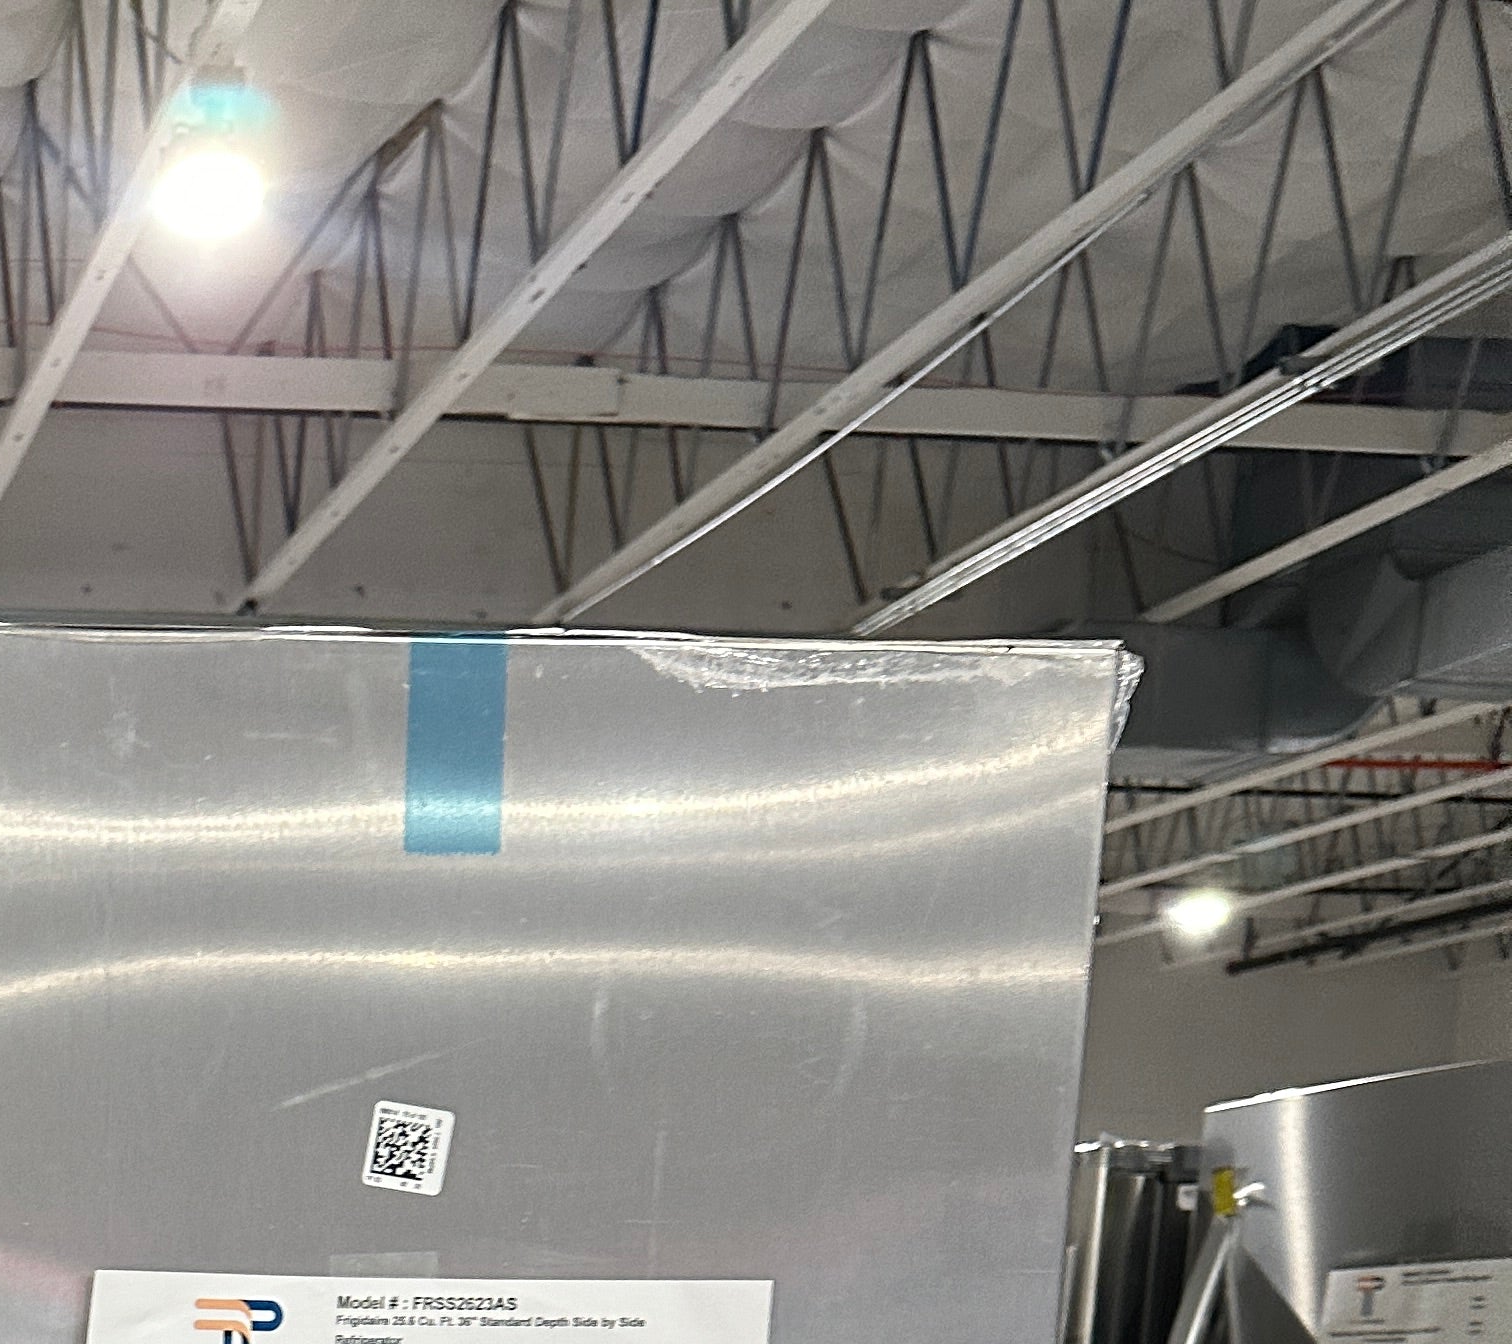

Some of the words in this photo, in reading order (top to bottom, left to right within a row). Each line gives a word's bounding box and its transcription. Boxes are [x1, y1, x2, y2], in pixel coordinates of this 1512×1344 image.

[337, 1296, 385, 1310] Model
[387, 1297, 399, 1310] #
[335, 1315, 389, 1328] Frigidaire
[479, 1316, 532, 1327] Standard
[534, 1317, 570, 1330] Depth
[572, 1317, 598, 1328] Side
[600, 1317, 616, 1330] by
[618, 1317, 646, 1328] Side
